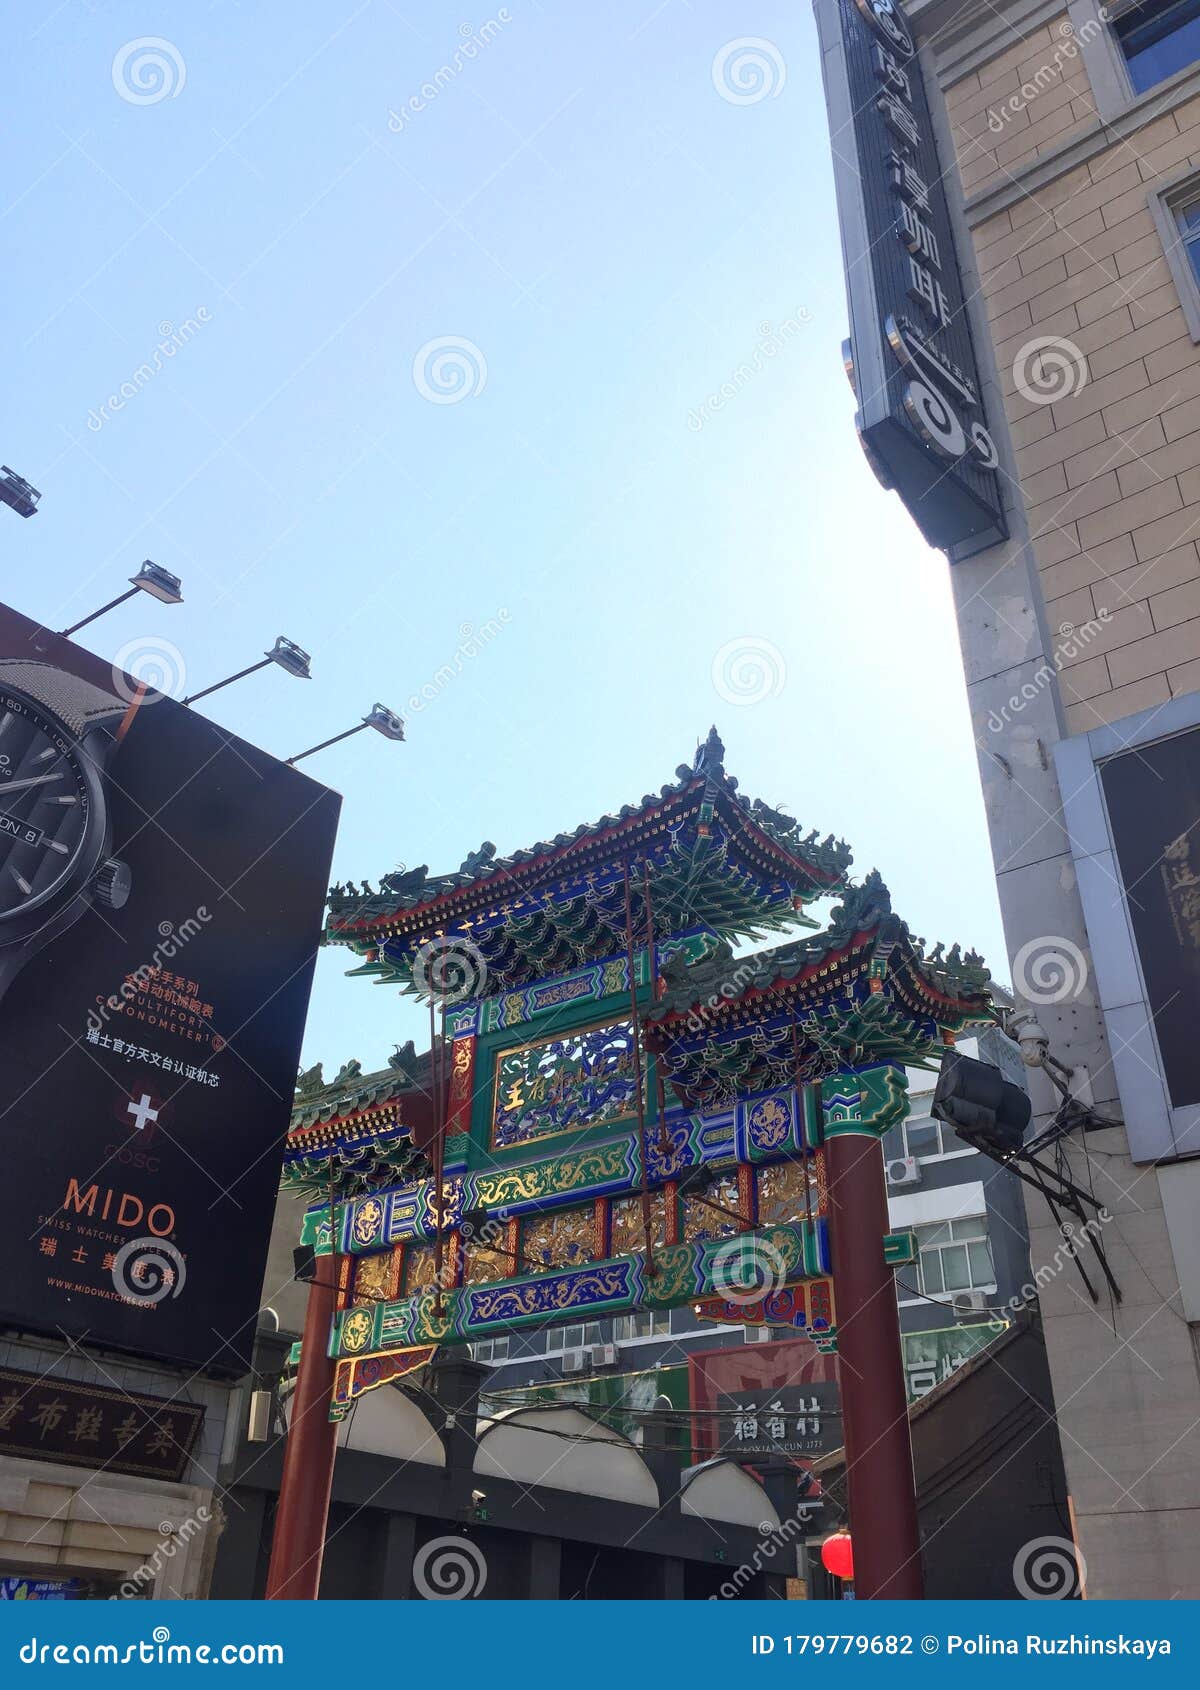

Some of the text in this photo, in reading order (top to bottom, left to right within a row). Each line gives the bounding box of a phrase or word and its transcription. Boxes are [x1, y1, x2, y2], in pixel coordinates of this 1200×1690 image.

[86, 1027, 220, 1088] 瑞士官方天文台认证机芯
[37, 1215, 72, 1231] SWISS
[77, 1224, 126, 1246] WATCHES
[63, 1177, 176, 1237] MIDO
[38, 1237, 176, 1287] 瑞士美度表
